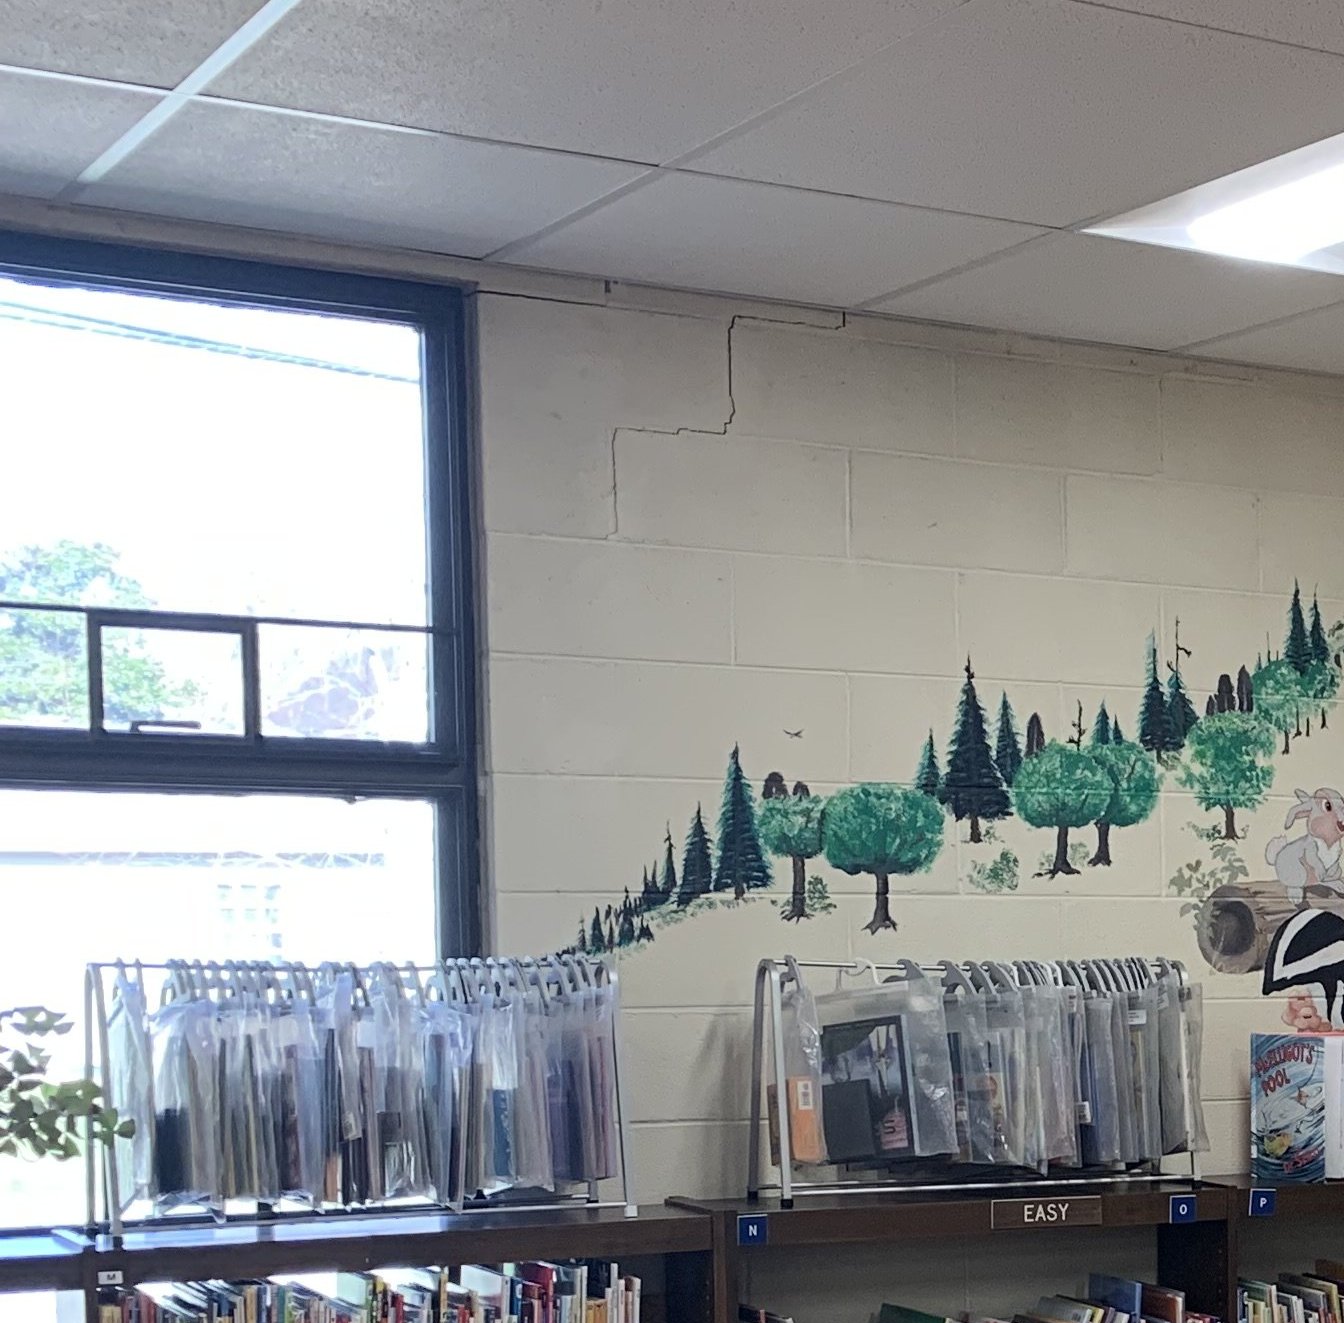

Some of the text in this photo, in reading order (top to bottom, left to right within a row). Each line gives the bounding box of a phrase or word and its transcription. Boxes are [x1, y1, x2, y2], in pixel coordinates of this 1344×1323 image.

[1260, 1068, 1291, 1097] POOL
[1258, 1197, 1269, 1208] P
[1024, 1202, 1070, 1222] EASY
[748, 1225, 758, 1237] N
